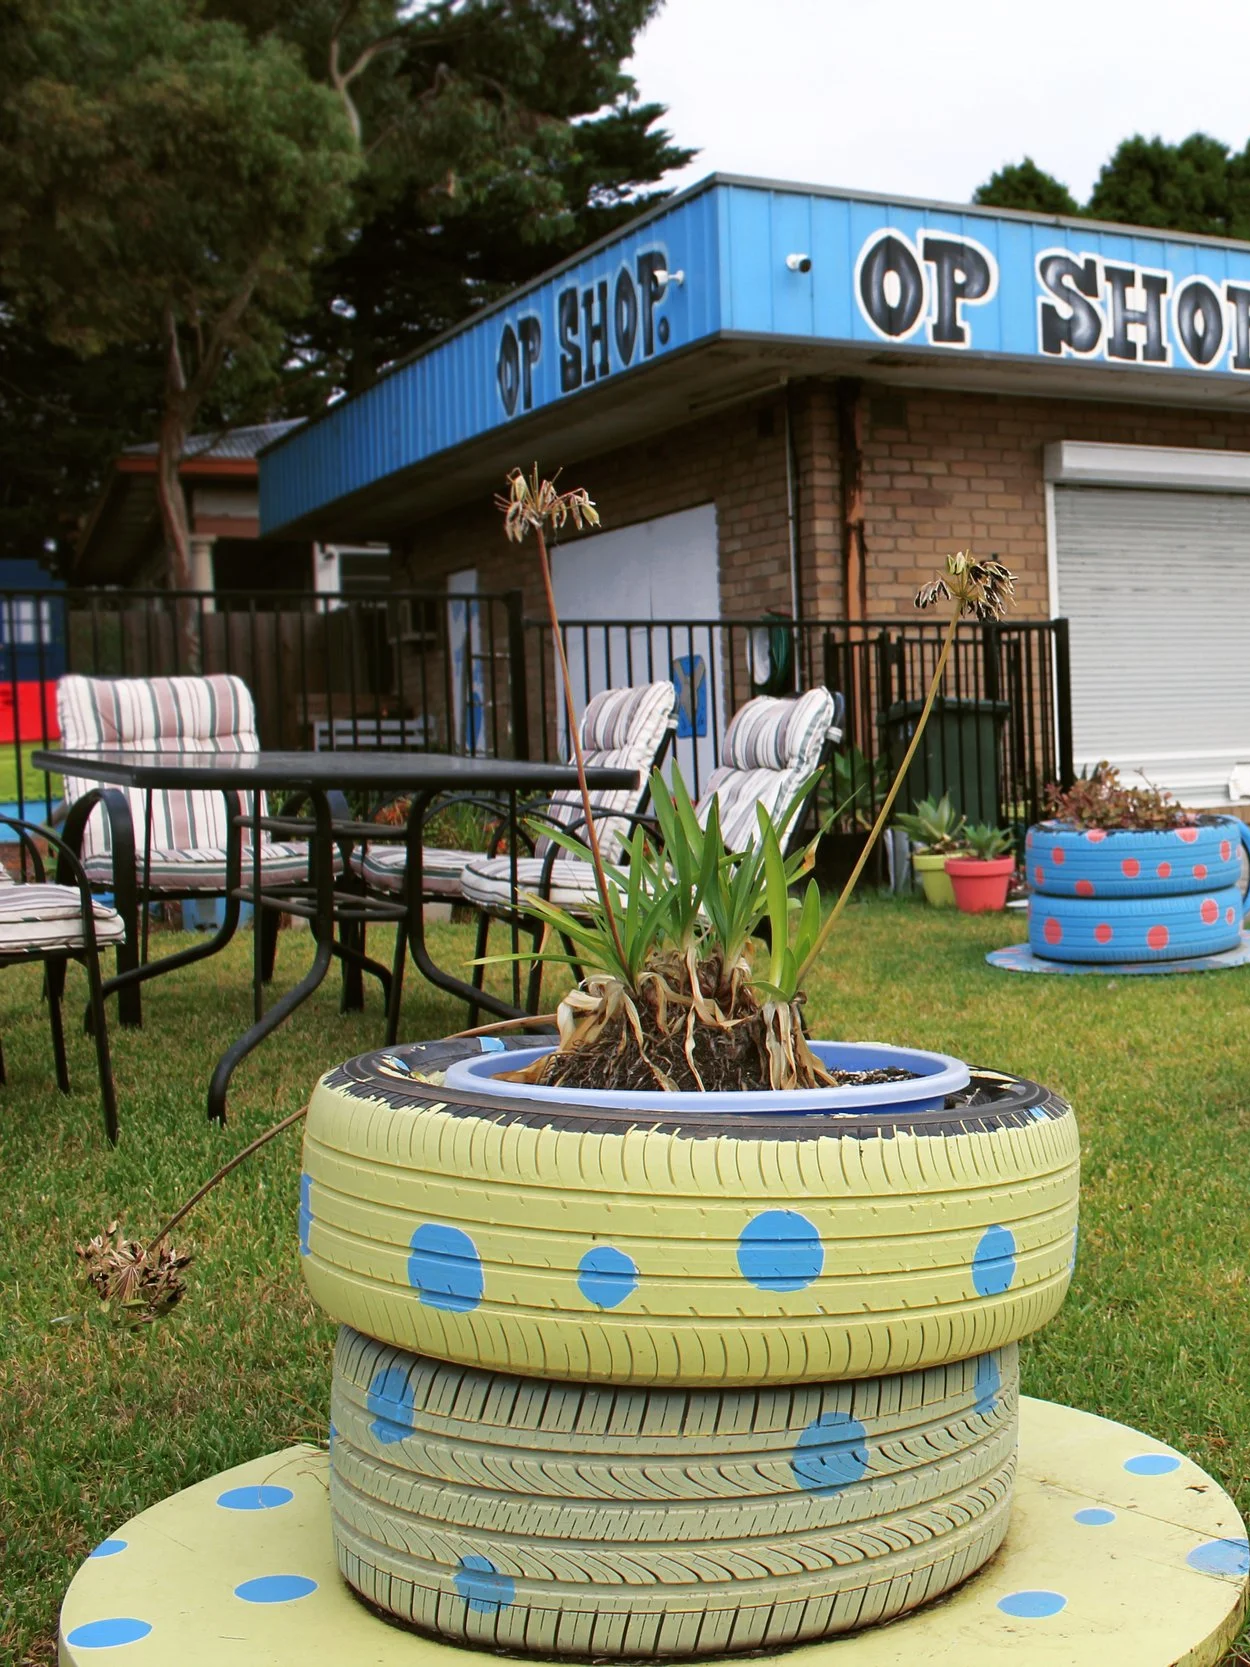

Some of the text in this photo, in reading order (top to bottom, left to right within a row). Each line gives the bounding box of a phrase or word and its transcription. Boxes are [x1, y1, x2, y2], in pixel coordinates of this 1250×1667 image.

[497, 246, 670, 418] OP SHOP.
[856, 230, 997, 347] OP
